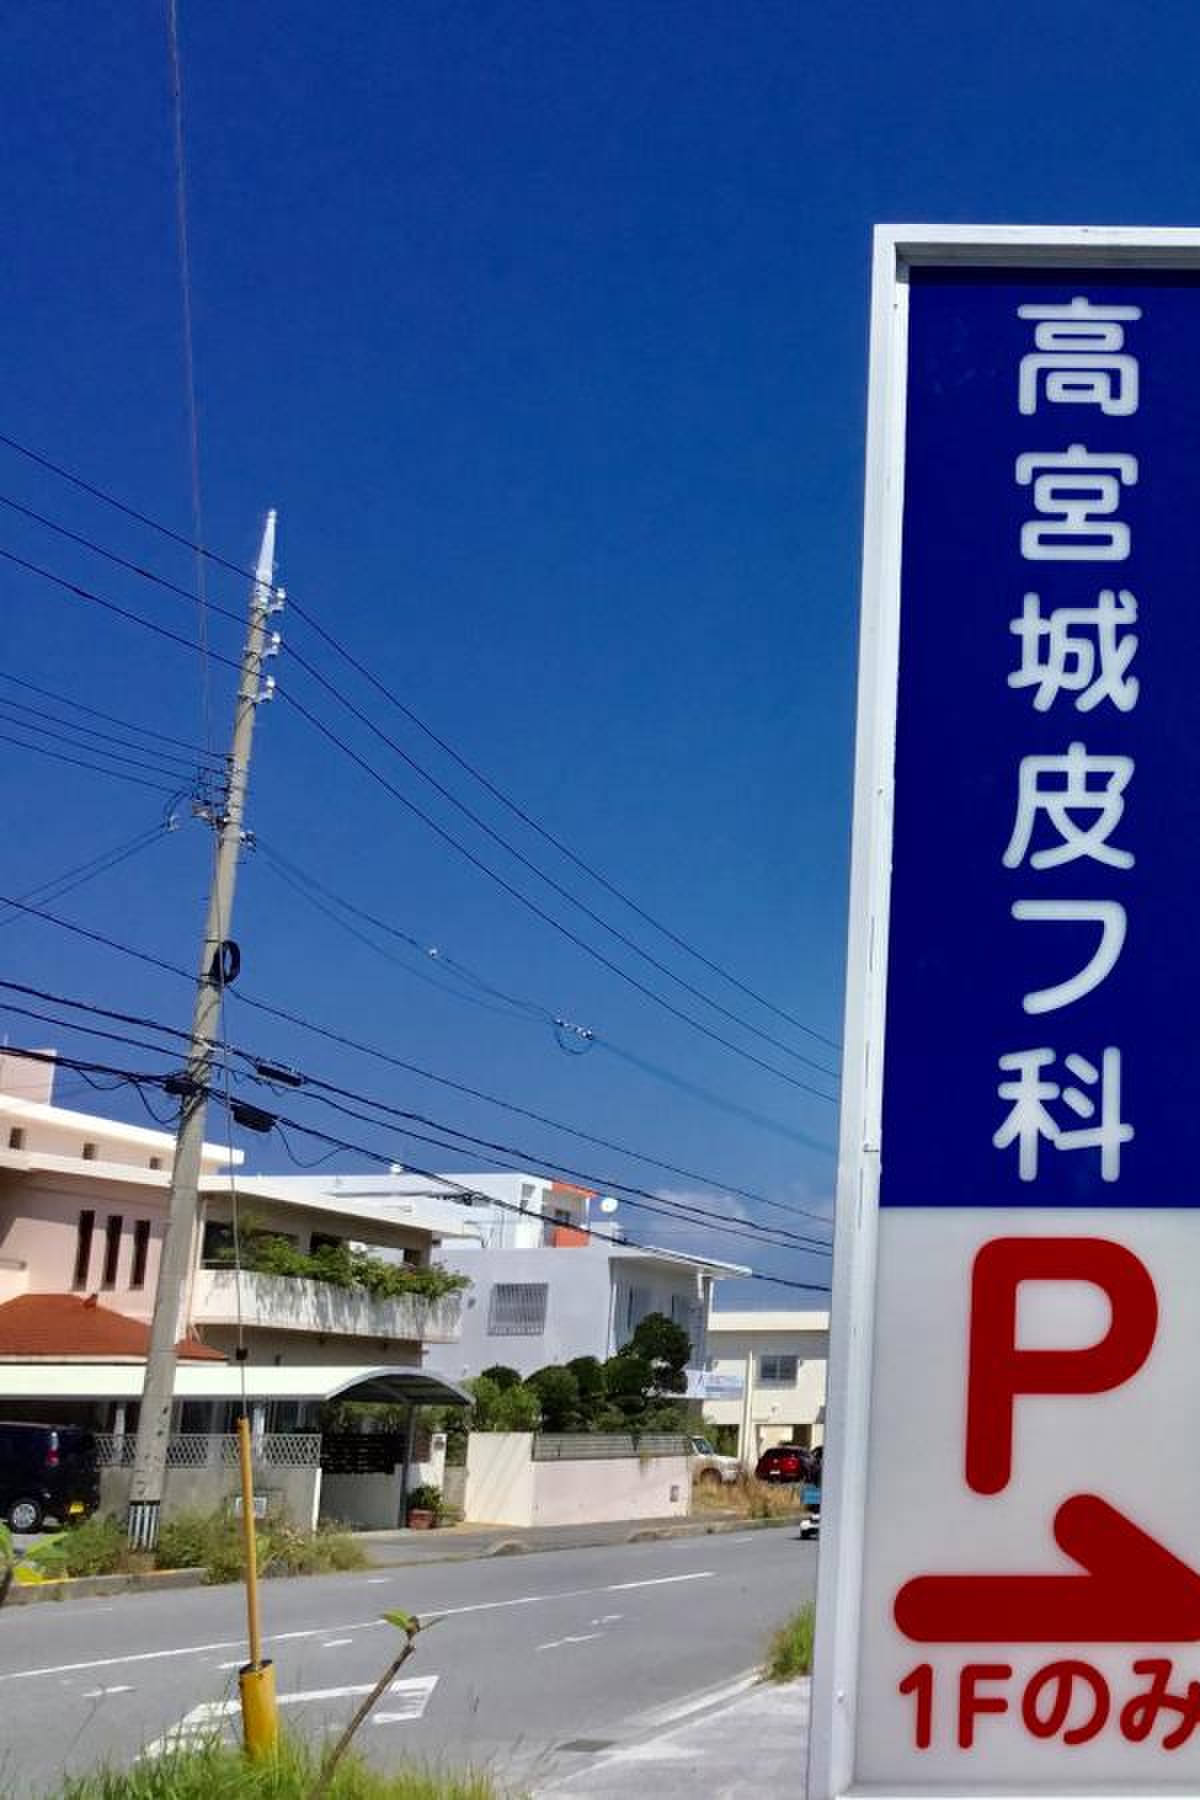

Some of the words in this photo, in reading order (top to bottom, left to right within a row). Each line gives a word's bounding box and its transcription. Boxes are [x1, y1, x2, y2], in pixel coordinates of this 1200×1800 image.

[993, 296, 1142, 1183] 高宮城皮フ科
[965, 1237, 1159, 1496] P
